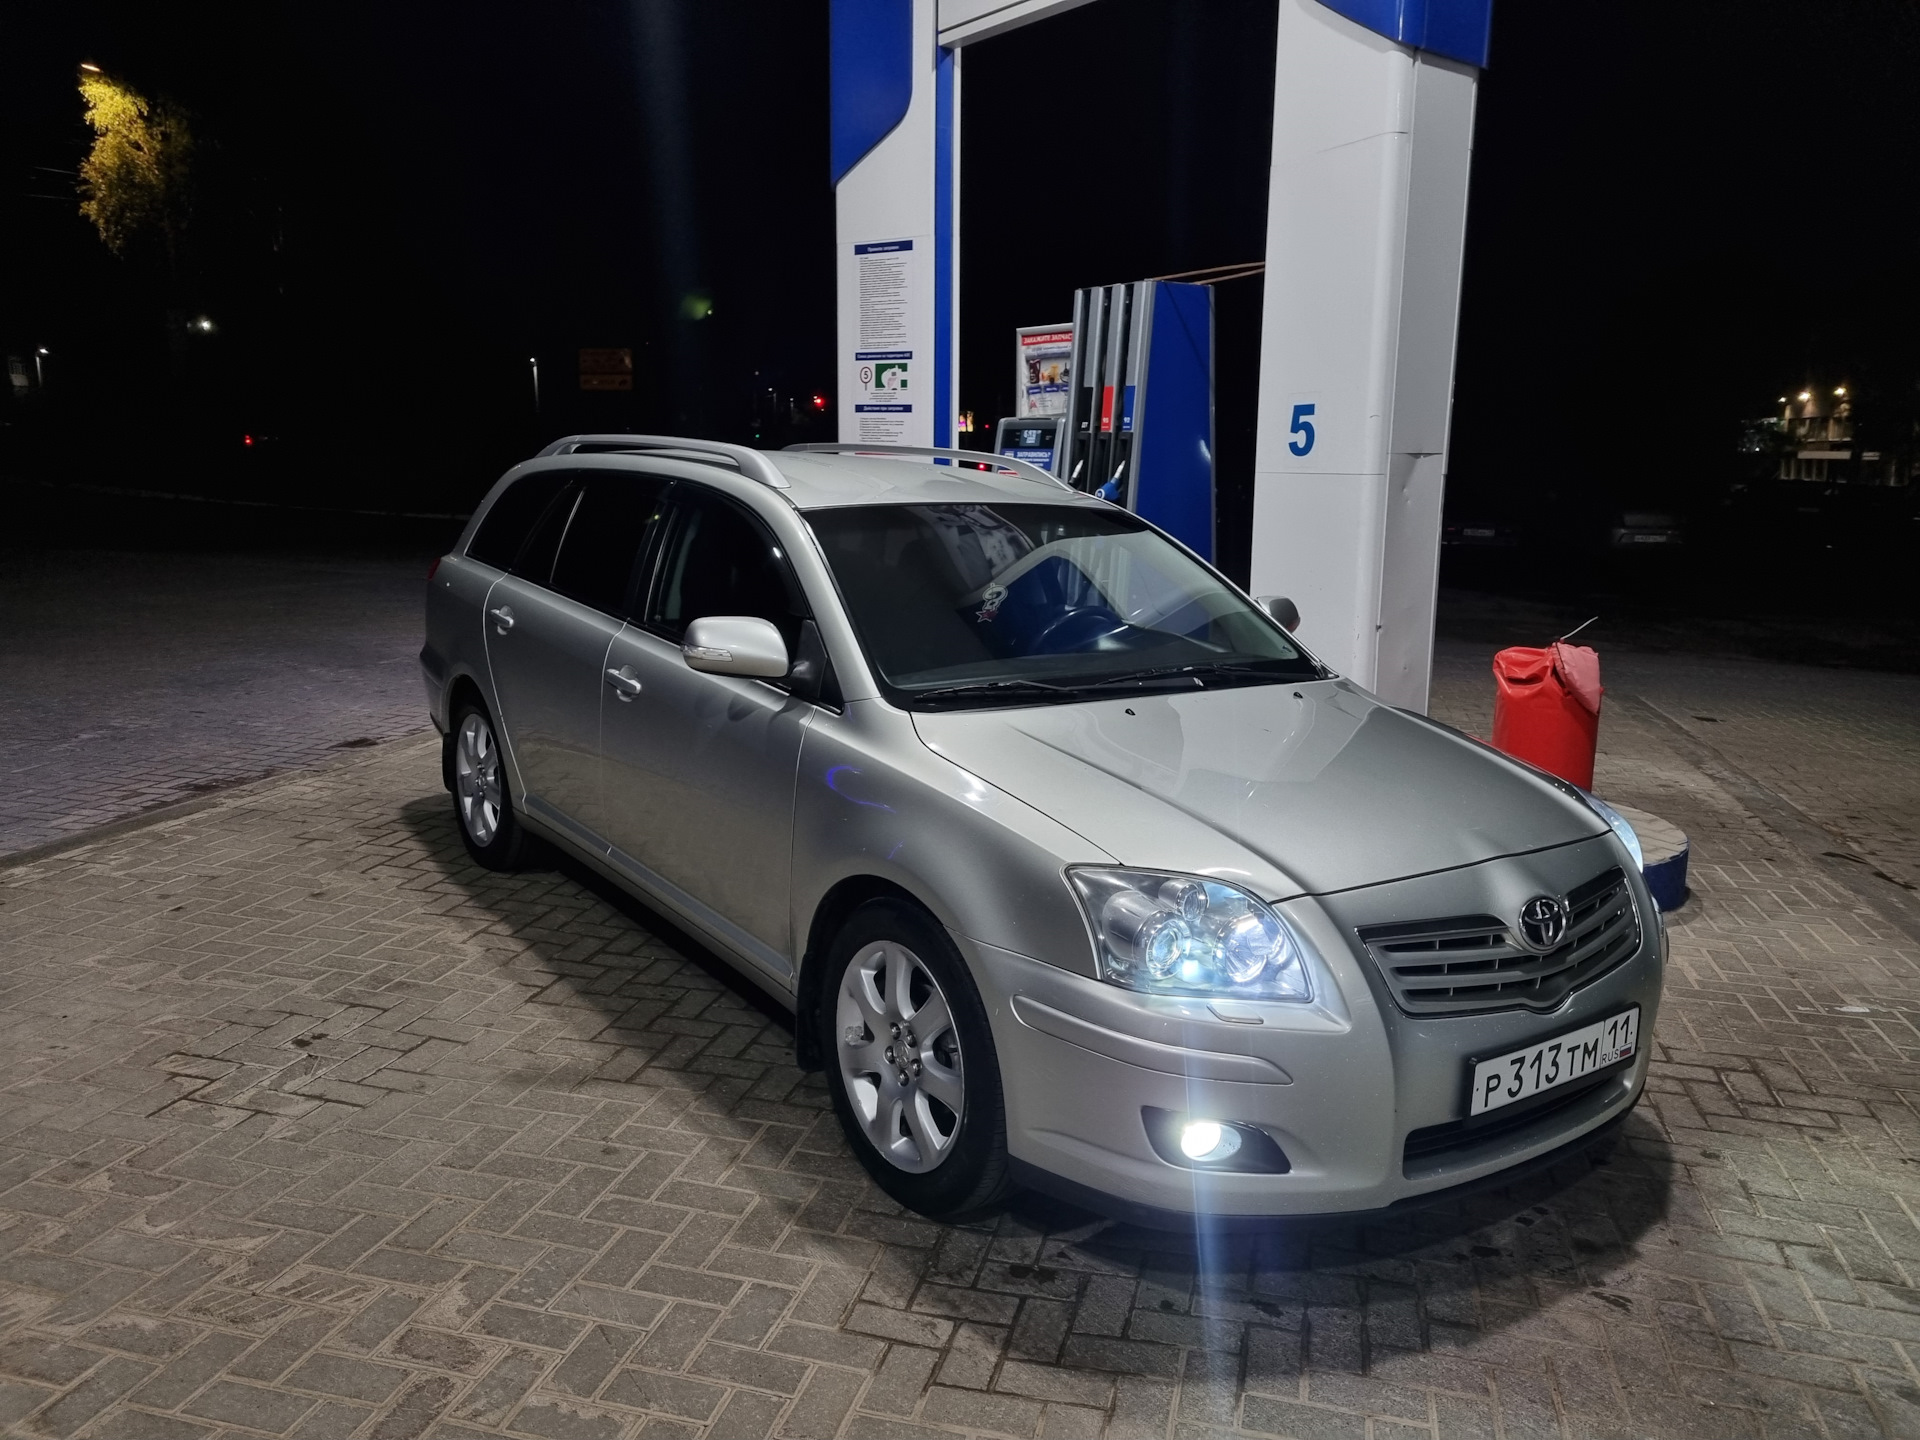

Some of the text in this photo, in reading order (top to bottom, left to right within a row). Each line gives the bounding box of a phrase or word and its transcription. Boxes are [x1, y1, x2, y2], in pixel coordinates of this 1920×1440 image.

[863, 370, 869, 379] 5
[1288, 403, 1315, 457] 5
[1608, 1014, 1630, 1049] 11
[1601, 1048, 1619, 1065] RUS
